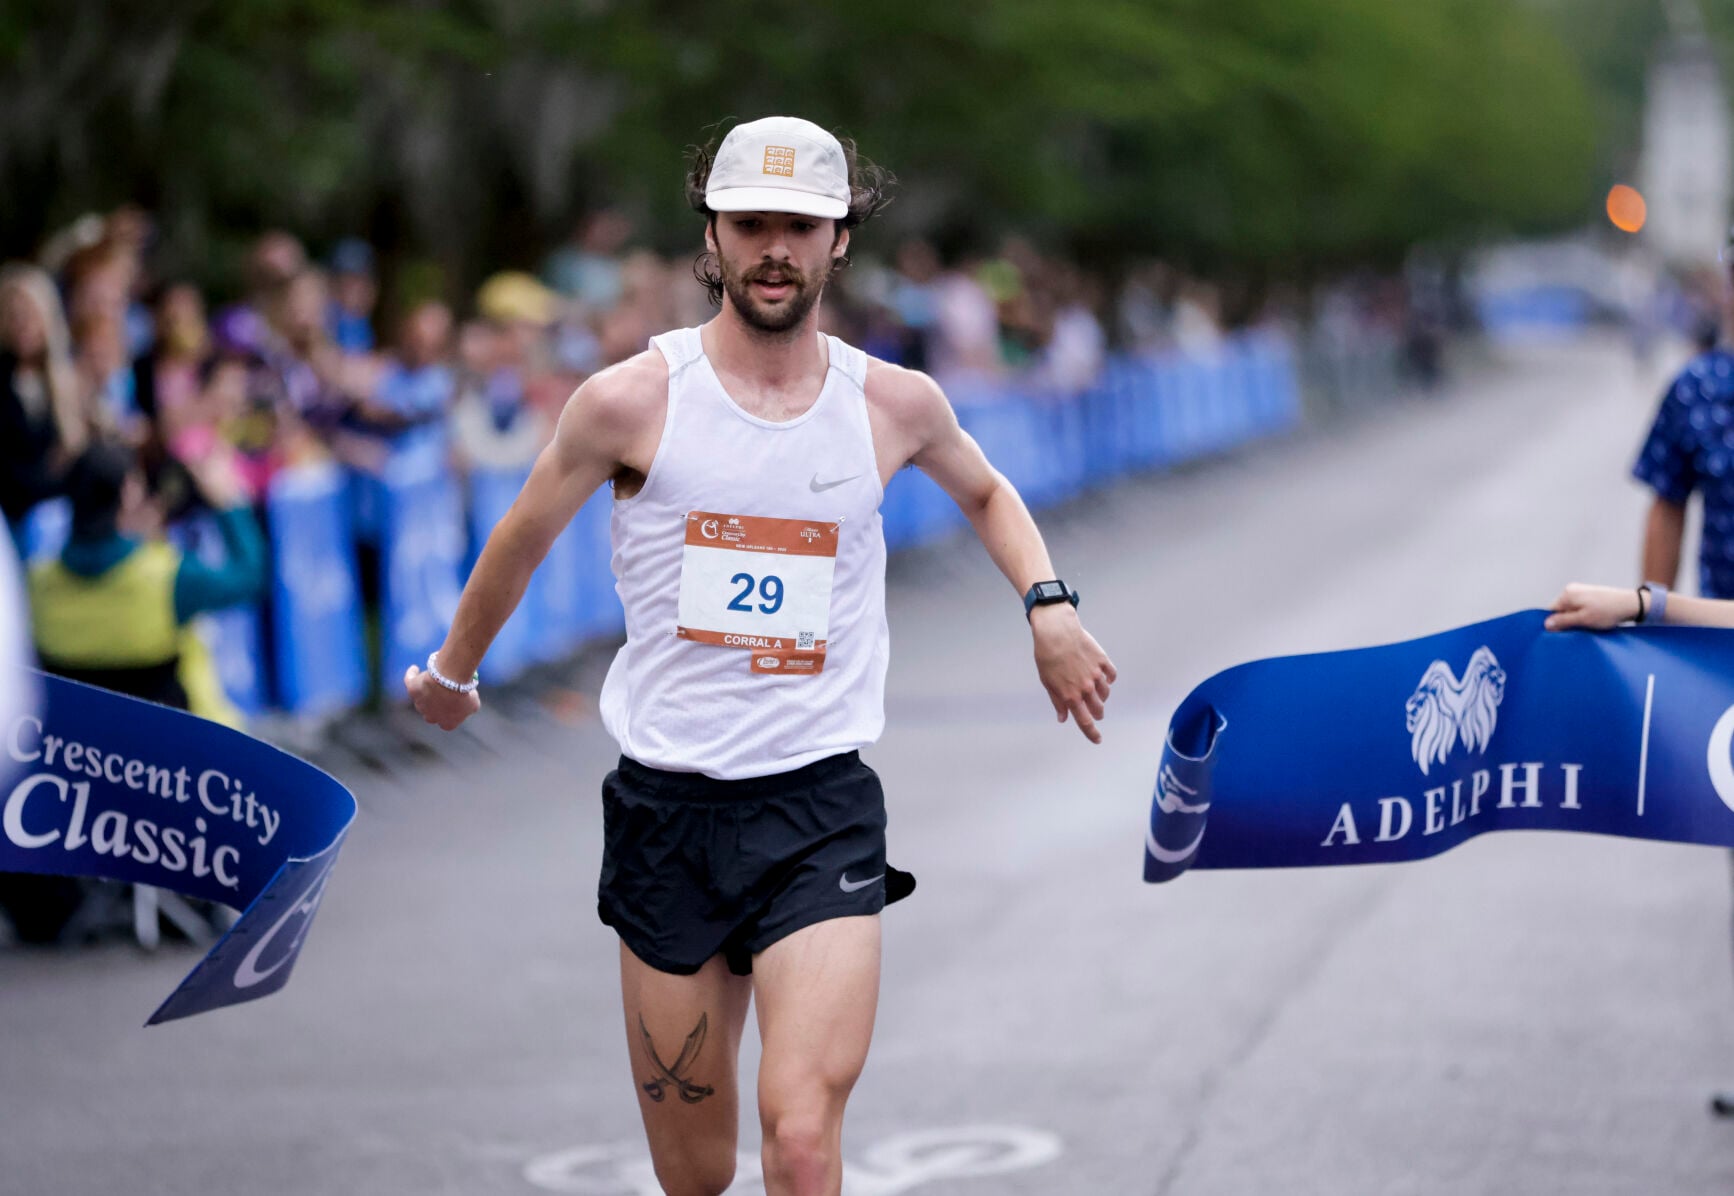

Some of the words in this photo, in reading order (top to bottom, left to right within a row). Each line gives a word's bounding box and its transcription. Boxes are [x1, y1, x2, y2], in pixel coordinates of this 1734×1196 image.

[800, 531, 821, 539] ULTRA
[727, 573, 784, 615] 29
[724, 634, 771, 648] CORRAL
[774, 640, 782, 649] A
[5, 715, 190, 802] Crescent
[197, 769, 280, 846] City
[1321, 763, 1583, 847] ADELPHI
[3, 773, 240, 888] Classic
